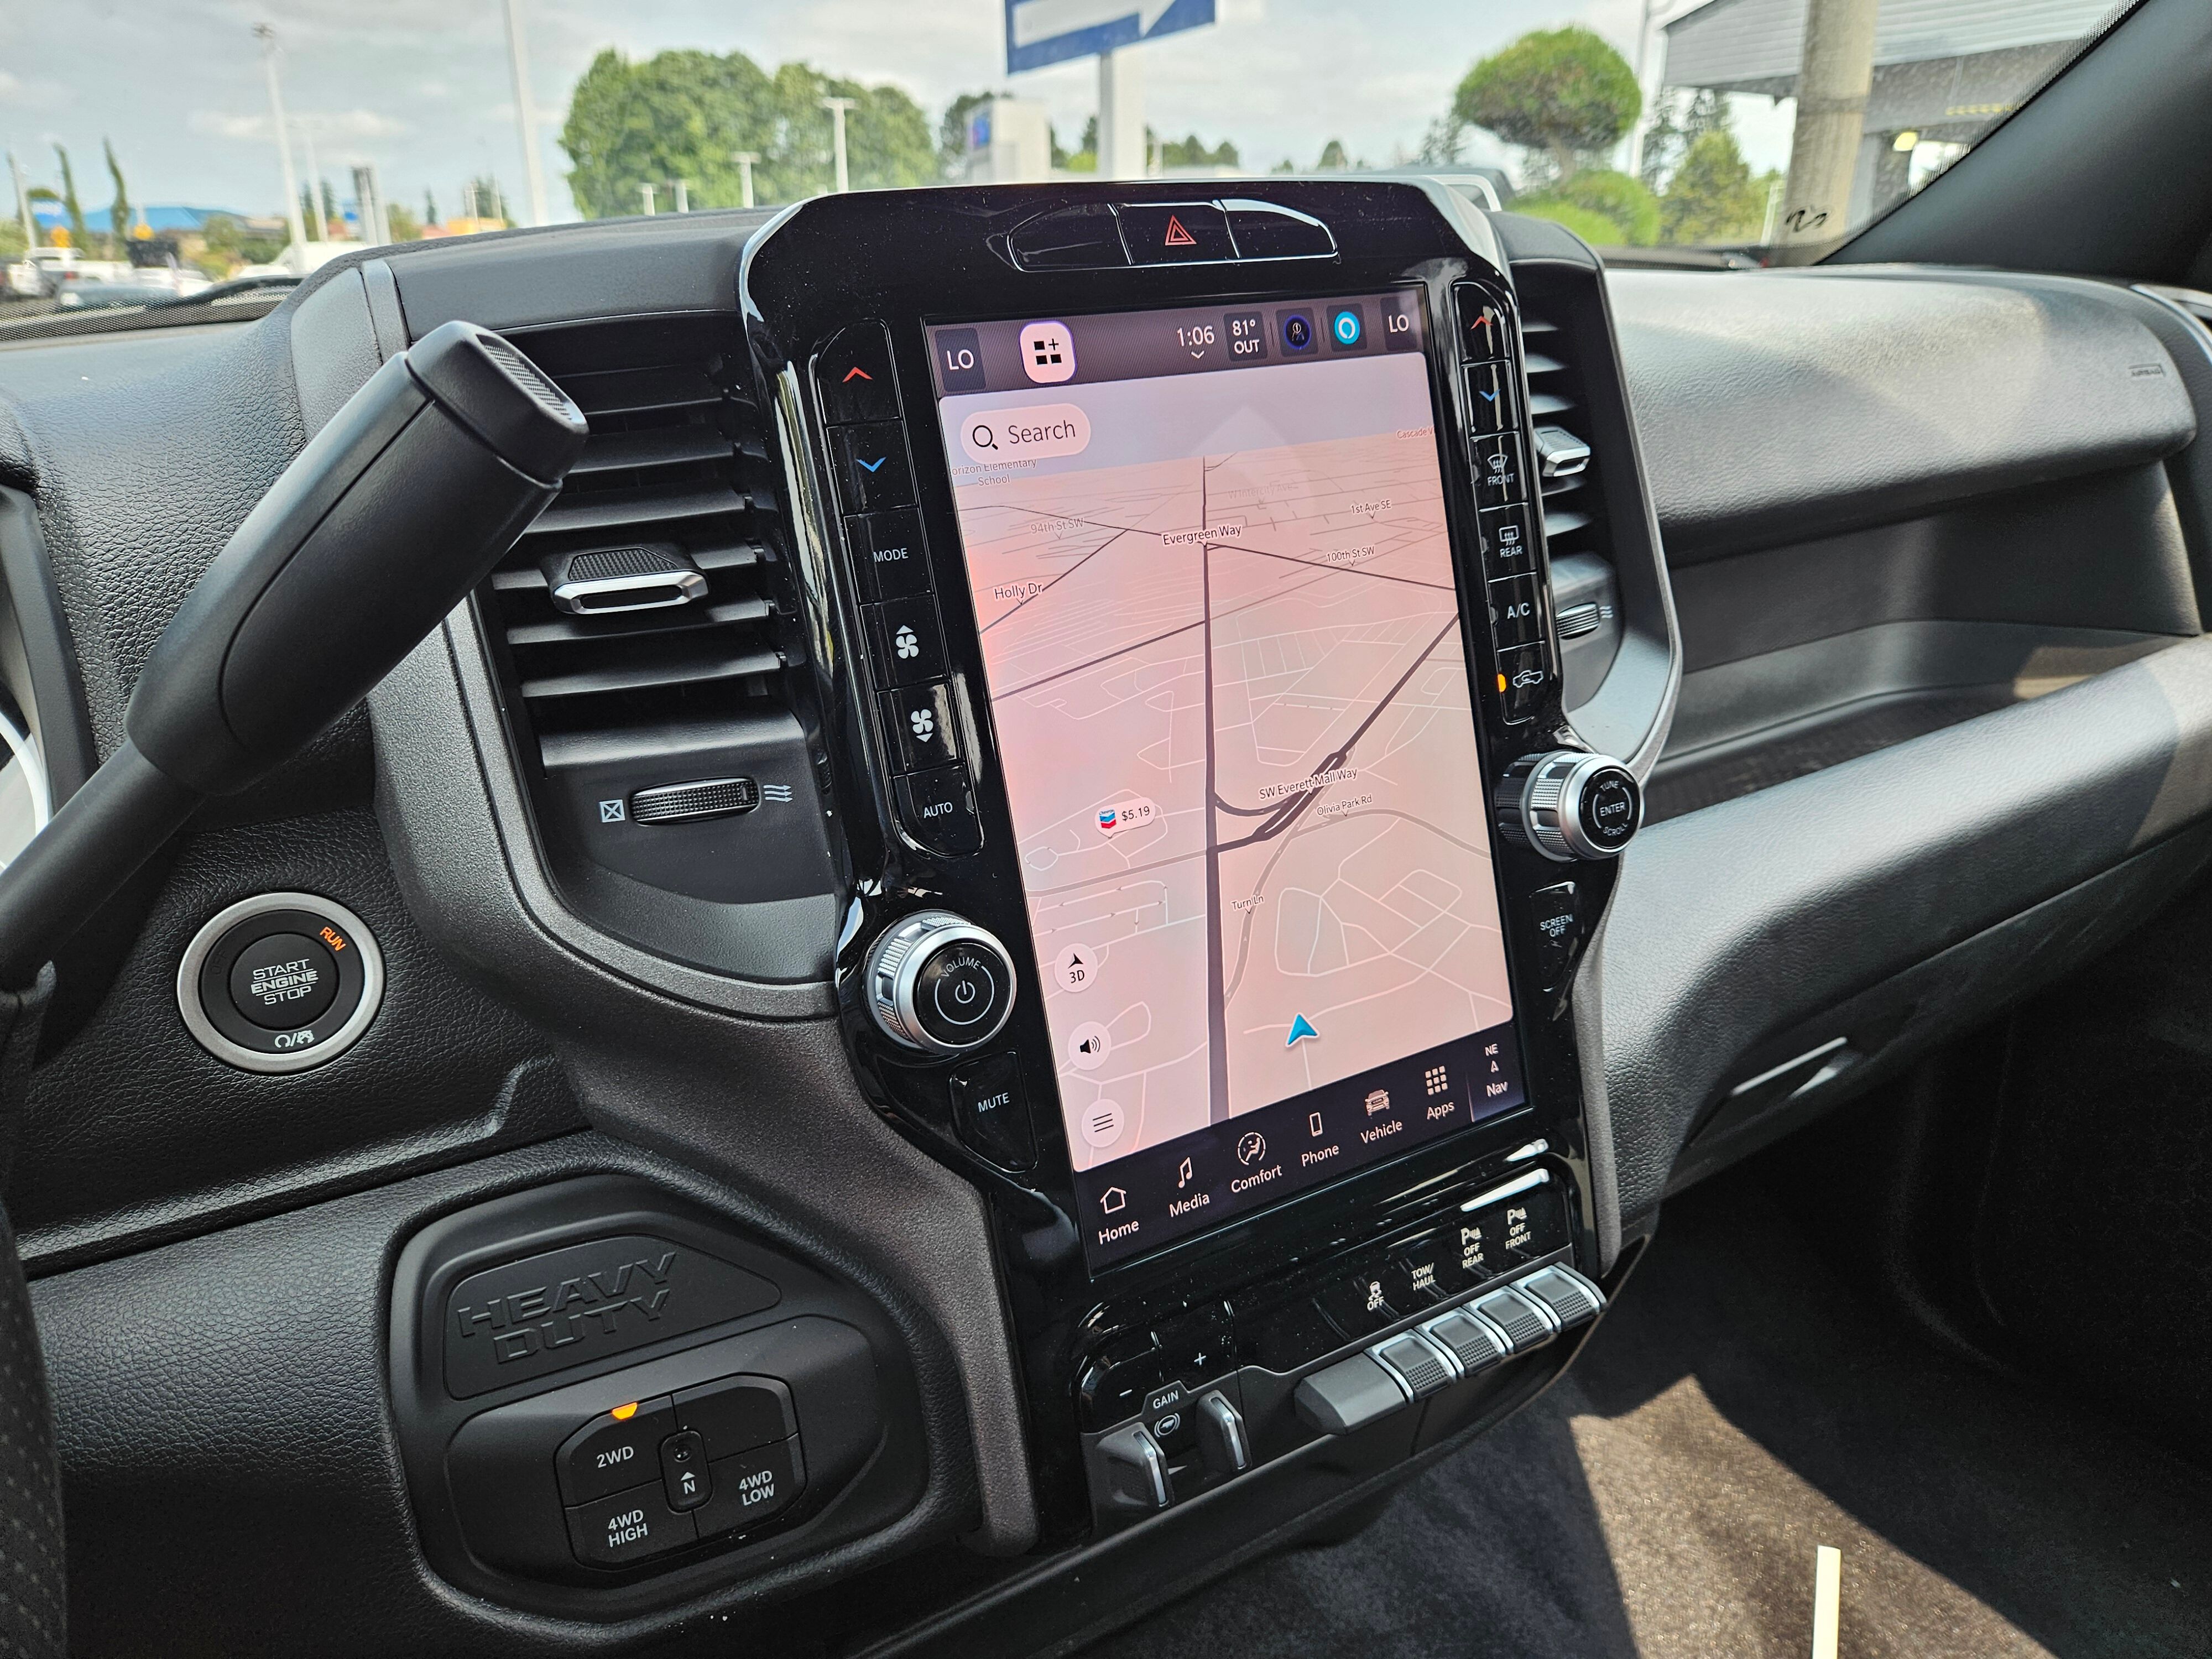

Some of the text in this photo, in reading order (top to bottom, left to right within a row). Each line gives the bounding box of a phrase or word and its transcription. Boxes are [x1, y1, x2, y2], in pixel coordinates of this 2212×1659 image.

[1388, 314, 1409, 333] LO
[1177, 325, 1215, 347] 1:06
[1234, 339, 1260, 354] OUT
[947, 349, 974, 370] LO
[1008, 420, 1076, 444] Search
[1397, 428, 1427, 439] Cascade
[984, 460, 1037, 472] Elementary
[978, 474, 1010, 486] School
[1487, 473, 1515, 487] FRONT
[1351, 500, 1391, 514] 1st Ave SE
[1030, 518, 1084, 534] 94th St SW
[1164, 524, 1241, 545] Evergreen Way
[873, 547, 909, 562] MODE
[1327, 546, 1375, 562] 100th St SW
[1500, 545, 1522, 558] REAR
[994, 583, 1042, 600] Holly Dr
[1507, 602, 1530, 619] A/C
[1259, 769, 1357, 799] SW Everett Mall Way
[1600, 780, 1620, 791] TUNE
[924, 802, 953, 818] AUTO
[1121, 806, 1150, 821] $5.19
[1317, 795, 1372, 816] Olivia Park Rd
[1600, 801, 1625, 817] ENTER
[1603, 822, 1629, 837] SCROLL
[1232, 894, 1264, 911] Turn Ln
[1540, 914, 1574, 931] SCREEN
[1549, 925, 1567, 937] OFF
[320, 926, 346, 952] RUN
[253, 958, 310, 980] START
[940, 956, 982, 978] VOLUME
[251, 971, 319, 994] ENGINE
[1069, 969, 1085, 983] 3D
[264, 985, 312, 1005] STOP
[1485, 1043, 1499, 1056] NE
[1486, 1081, 1508, 1098] Nav
[978, 1092, 1010, 1113] MUTE
[1427, 1100, 1455, 1121] Apps
[1360, 1120, 1402, 1144] Vehicle
[1301, 1144, 1339, 1167] Phone
[1231, 1165, 1282, 1193] Comfort
[1169, 1193, 1210, 1217] Media
[1098, 1220, 1139, 1245] Home
[1510, 1223, 1526, 1236] OFF
[1505, 1231, 1531, 1250] FRONT
[1464, 1243, 1480, 1258] OFF
[1462, 1253, 1484, 1269] REAR
[1411, 1262, 1434, 1280] TOW/
[1413, 1274, 1436, 1291] HAUL
[458, 1251, 677, 1338] HEAVY
[1367, 1296, 1384, 1311] OFF
[494, 1288, 670, 1364] DUTY
[1152, 1390, 1180, 1409] GAIN
[596, 1446, 634, 1468] 2WD
[684, 1480, 696, 1494] N
[739, 1470, 773, 1491] 4WD
[742, 1484, 775, 1506] LOW
[608, 1510, 644, 1531] 4WD
[608, 1523, 648, 1547] HIGH
